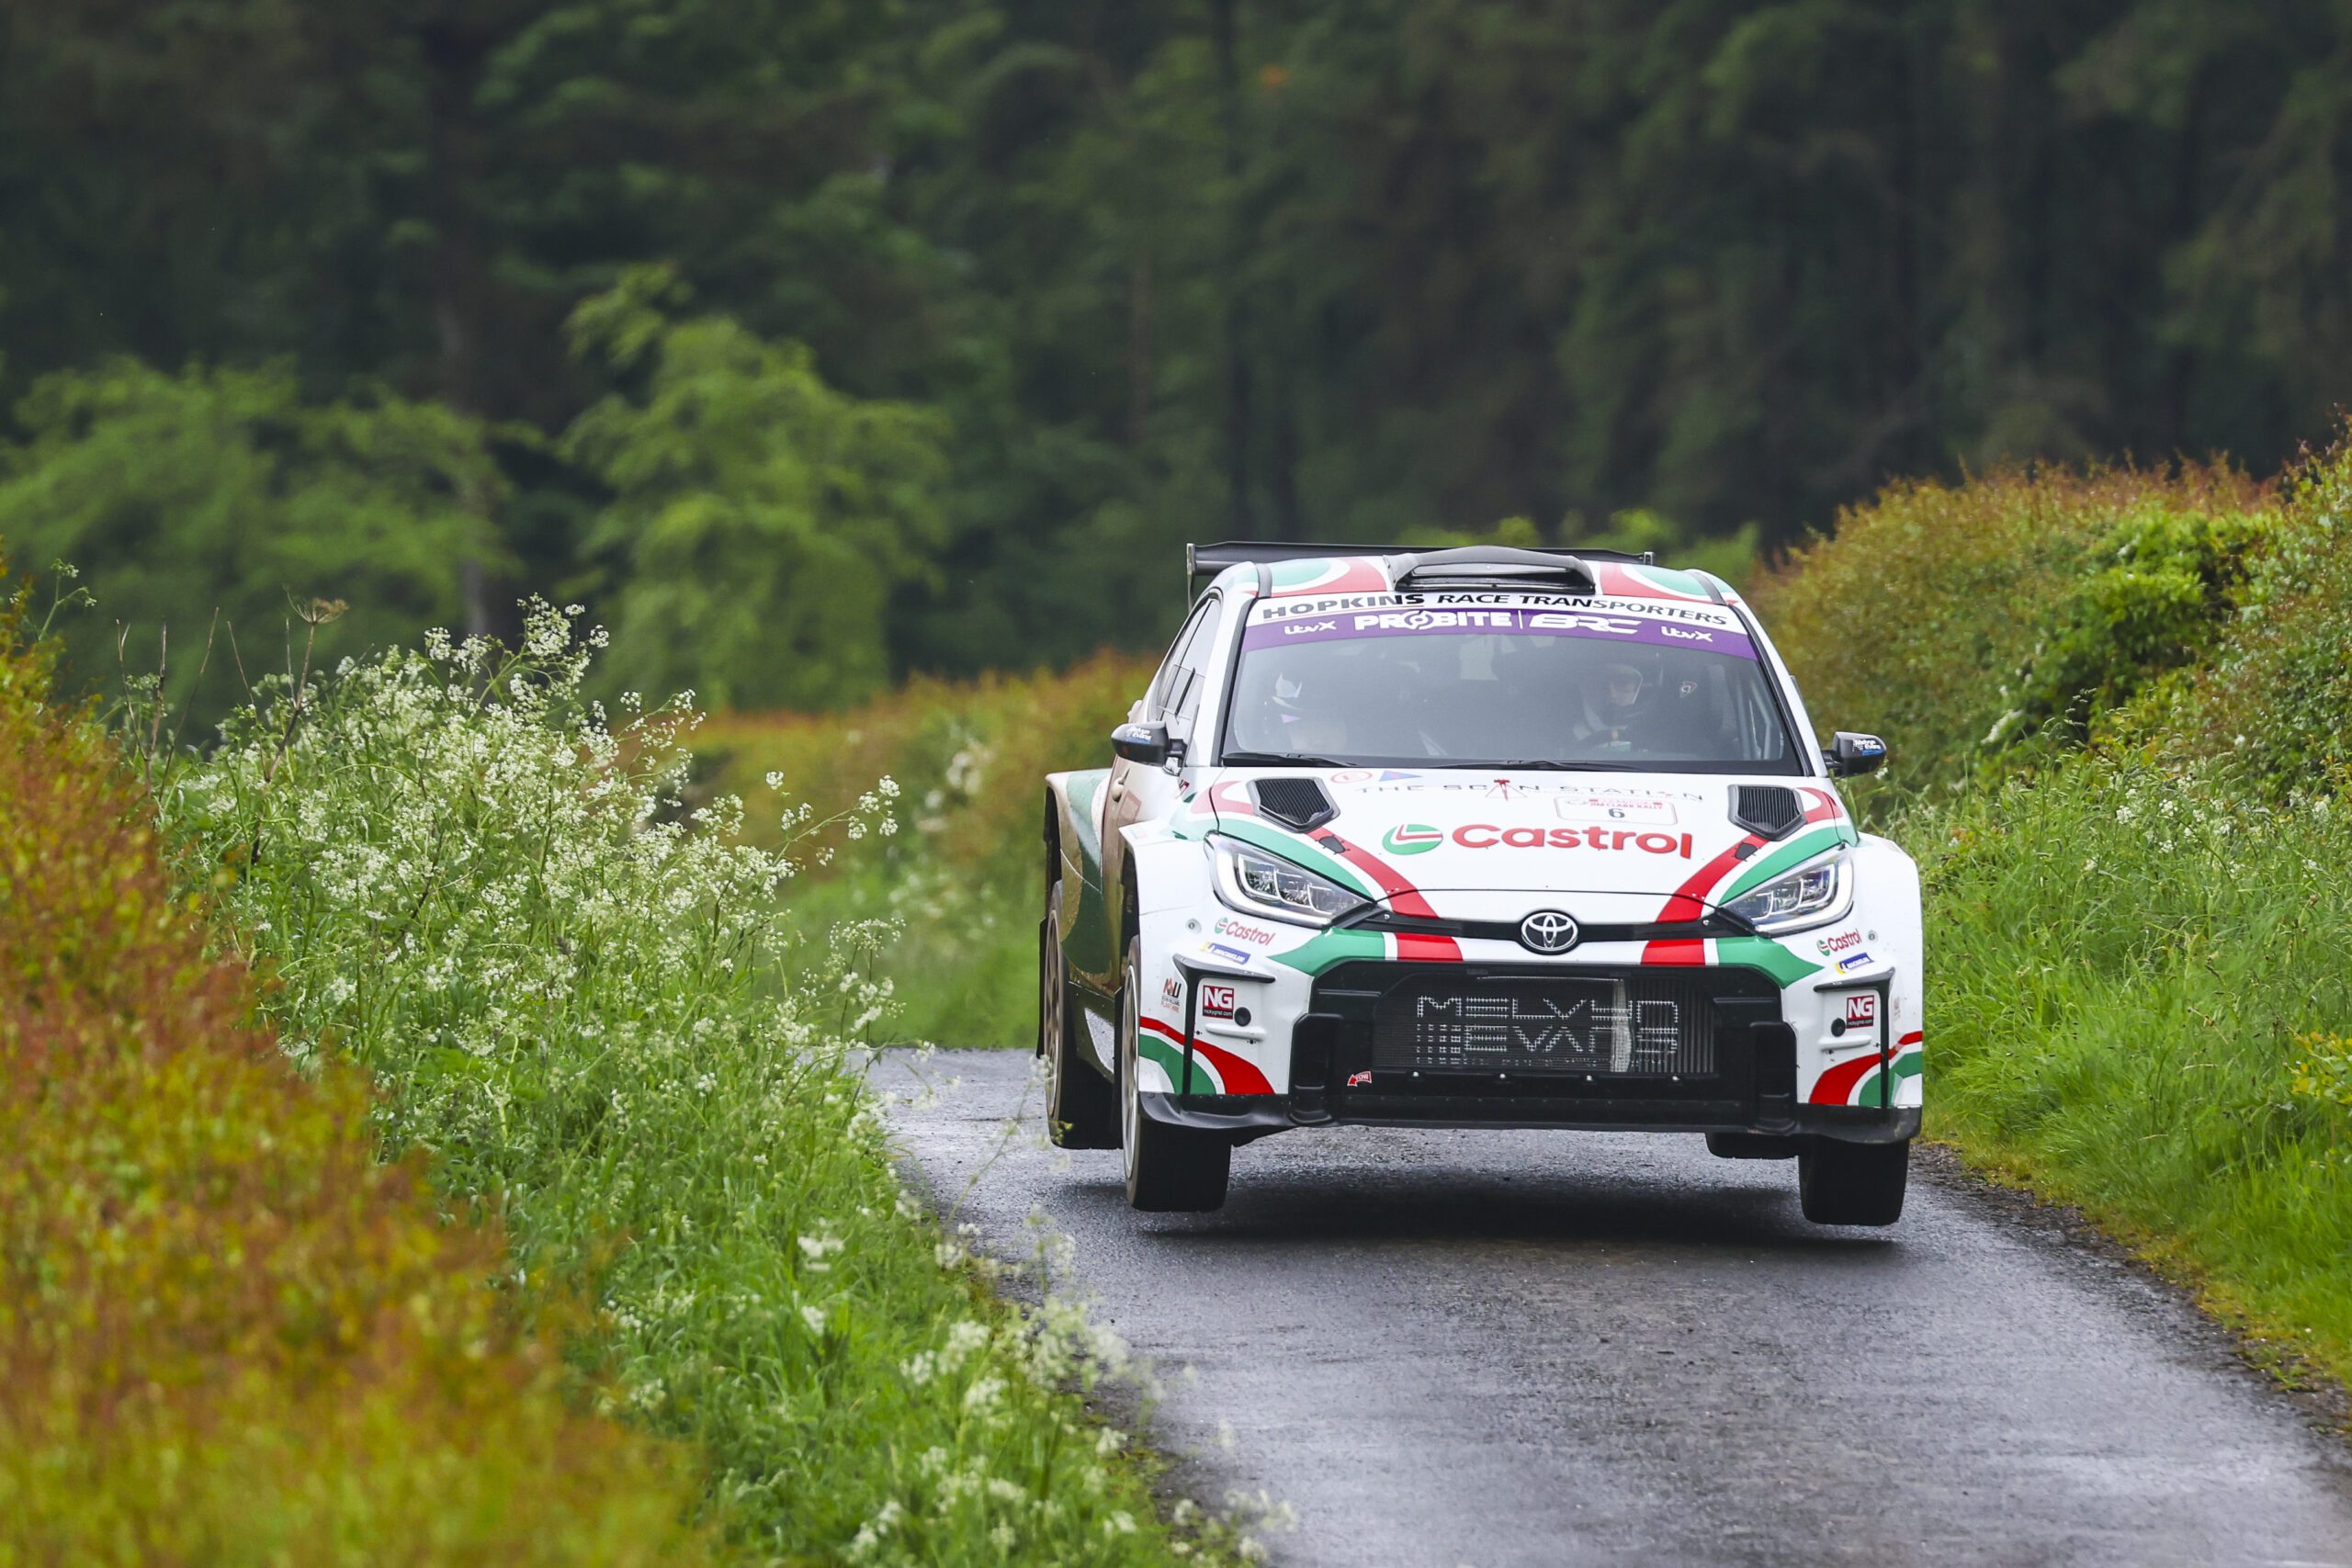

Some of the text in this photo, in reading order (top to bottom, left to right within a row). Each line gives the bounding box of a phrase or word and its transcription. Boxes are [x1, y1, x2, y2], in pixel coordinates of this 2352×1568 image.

[1262, 593, 1727, 626] HOPKINS RACE TRANSPORTERS
[1529, 613, 1643, 635] BRC
[1608, 808, 1625, 818] 6
[1451, 823, 1692, 860] Castrol
[1225, 921, 1275, 946] Castrol
[1826, 929, 1861, 953] Castrol
[1204, 987, 1234, 1010] NG
[1848, 997, 1874, 1019] NG
